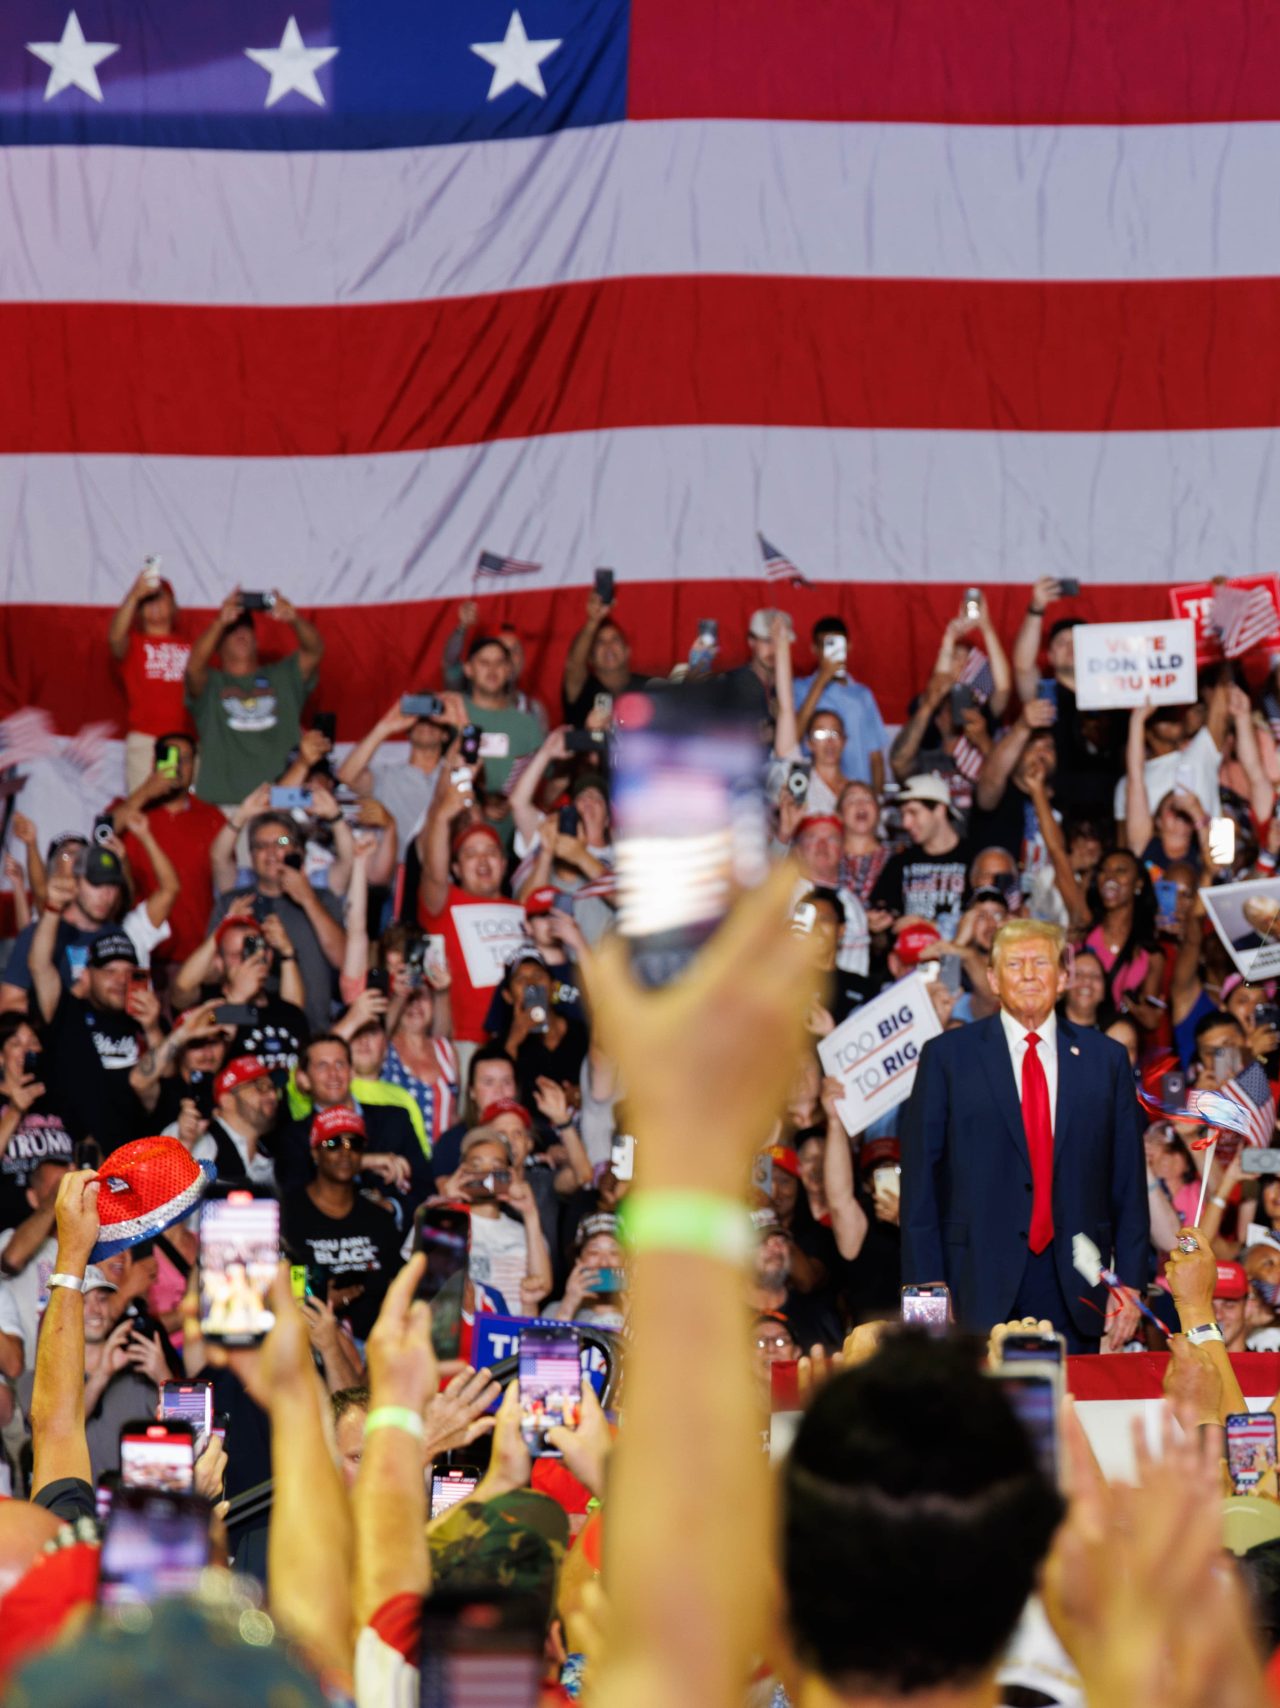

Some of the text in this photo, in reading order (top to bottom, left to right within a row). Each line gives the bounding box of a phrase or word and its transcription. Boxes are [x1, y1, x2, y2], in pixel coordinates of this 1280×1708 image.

[471, 919, 515, 938] TOO
[834, 1004, 914, 1069] TOO BIG
[853, 1041, 919, 1097] TO RIG
